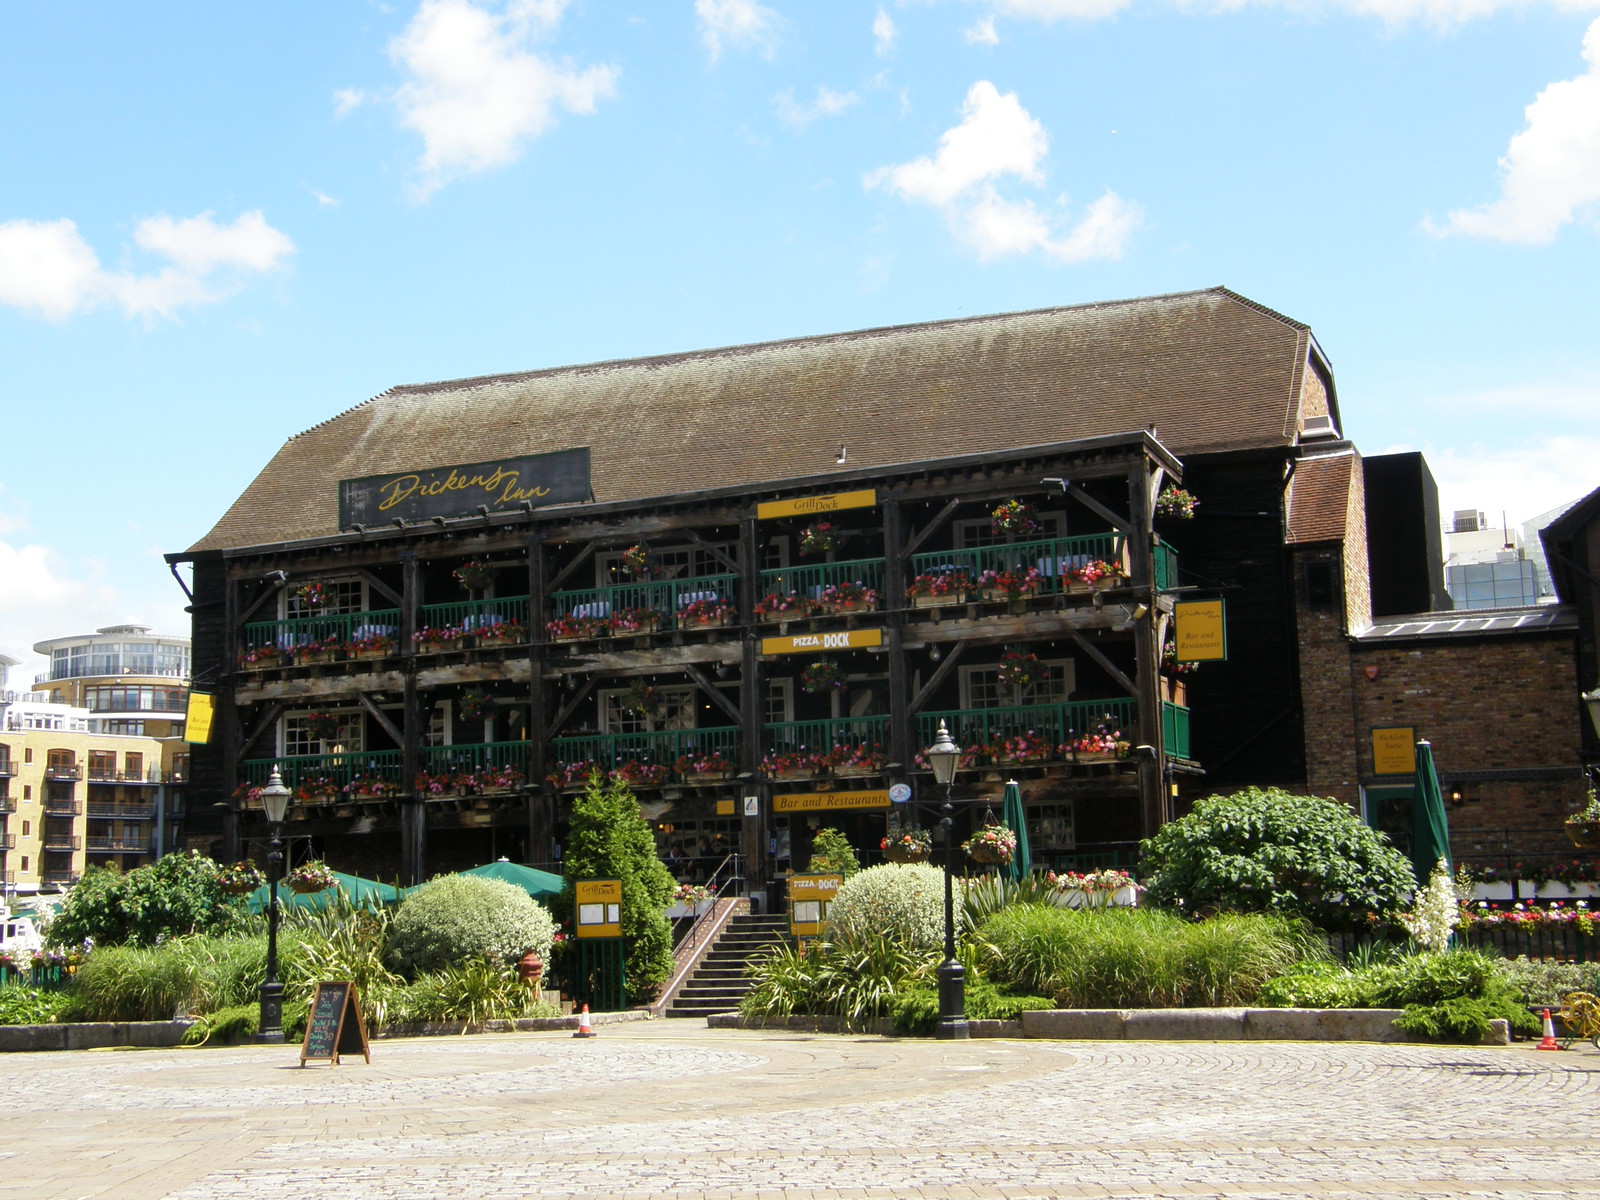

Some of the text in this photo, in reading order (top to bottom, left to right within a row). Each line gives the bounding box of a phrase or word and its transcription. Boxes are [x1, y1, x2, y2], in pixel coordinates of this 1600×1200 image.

[379, 466, 551, 510] Dickens Inn
[794, 498, 815, 510] Grill
[815, 500, 838, 511] Dock
[793, 633, 850, 648] PIZZA DOCK
[780, 798, 799, 809] Bar
[802, 796, 821, 808] and
[826, 793, 887, 807] Restaurants
[582, 885, 598, 893] Grill
[793, 878, 839, 890] PIZZA DOCK
